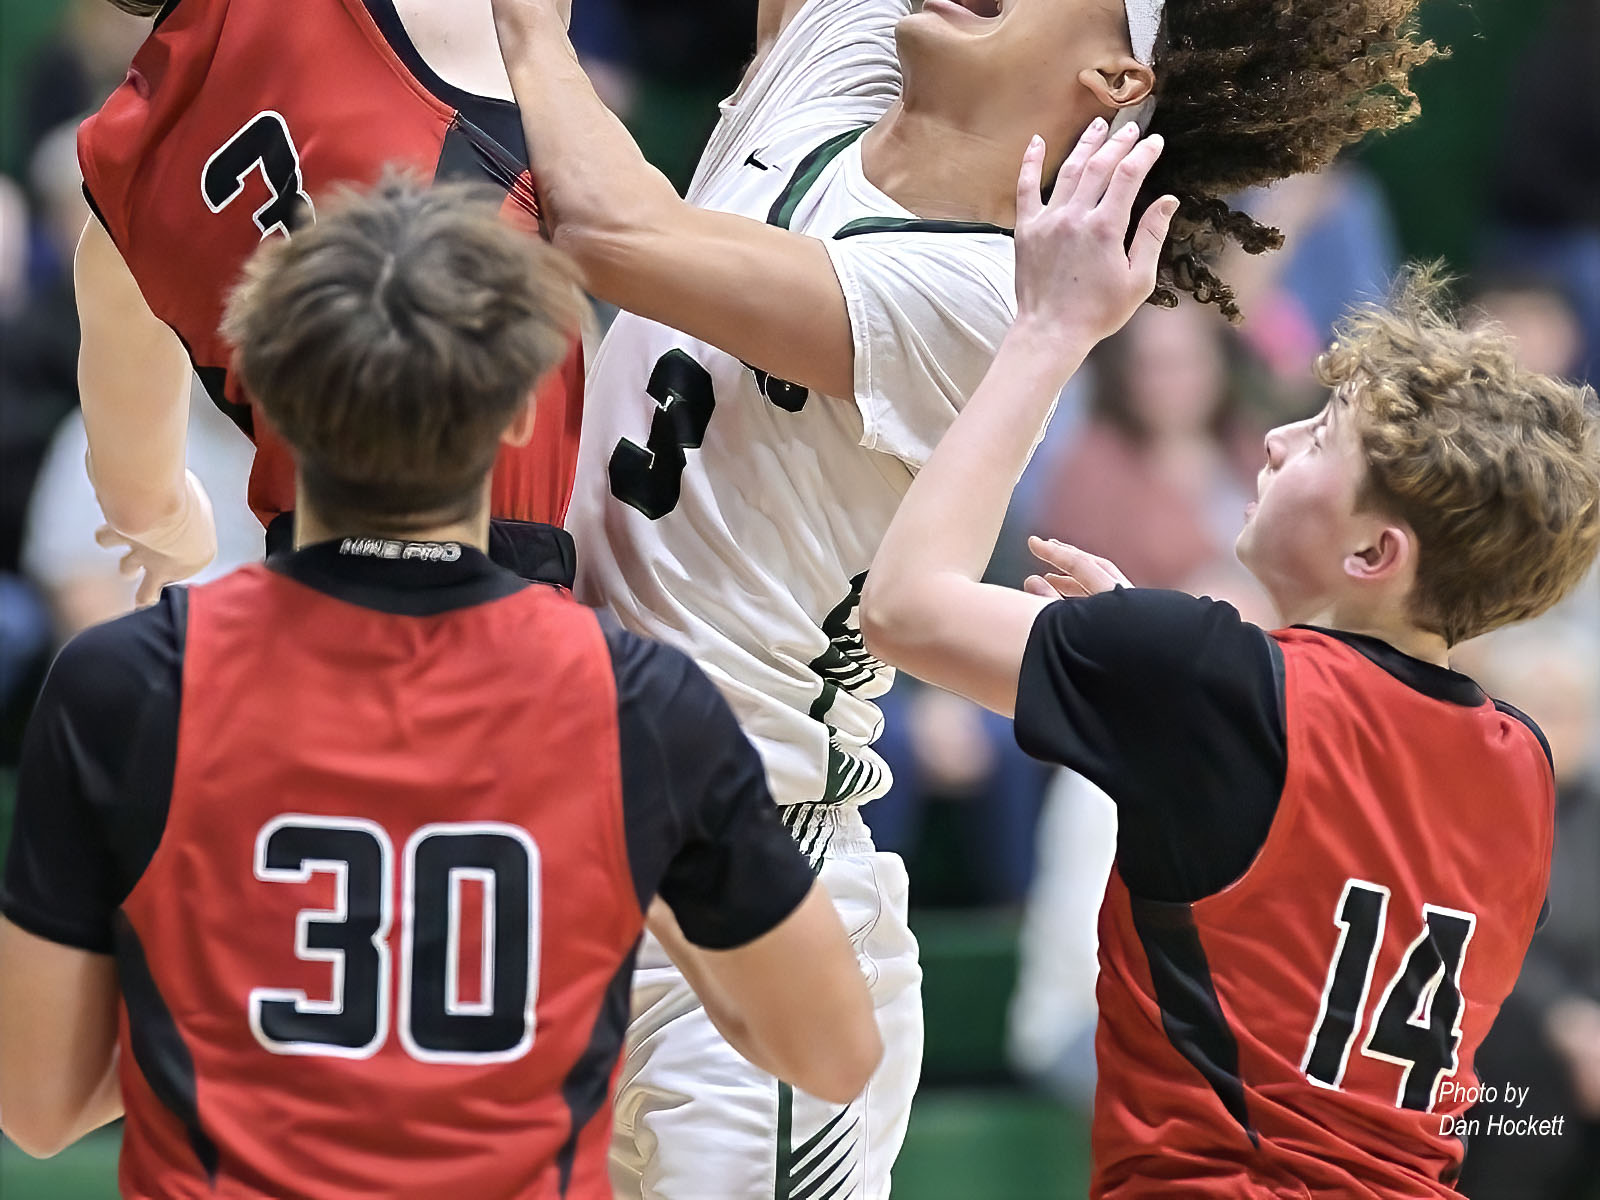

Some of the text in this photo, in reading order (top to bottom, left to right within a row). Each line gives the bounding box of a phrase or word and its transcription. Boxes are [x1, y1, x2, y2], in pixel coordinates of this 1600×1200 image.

[608, 347, 716, 521] 3
[248, 813, 541, 1064] 30
[1300, 878, 1476, 1114] 14
